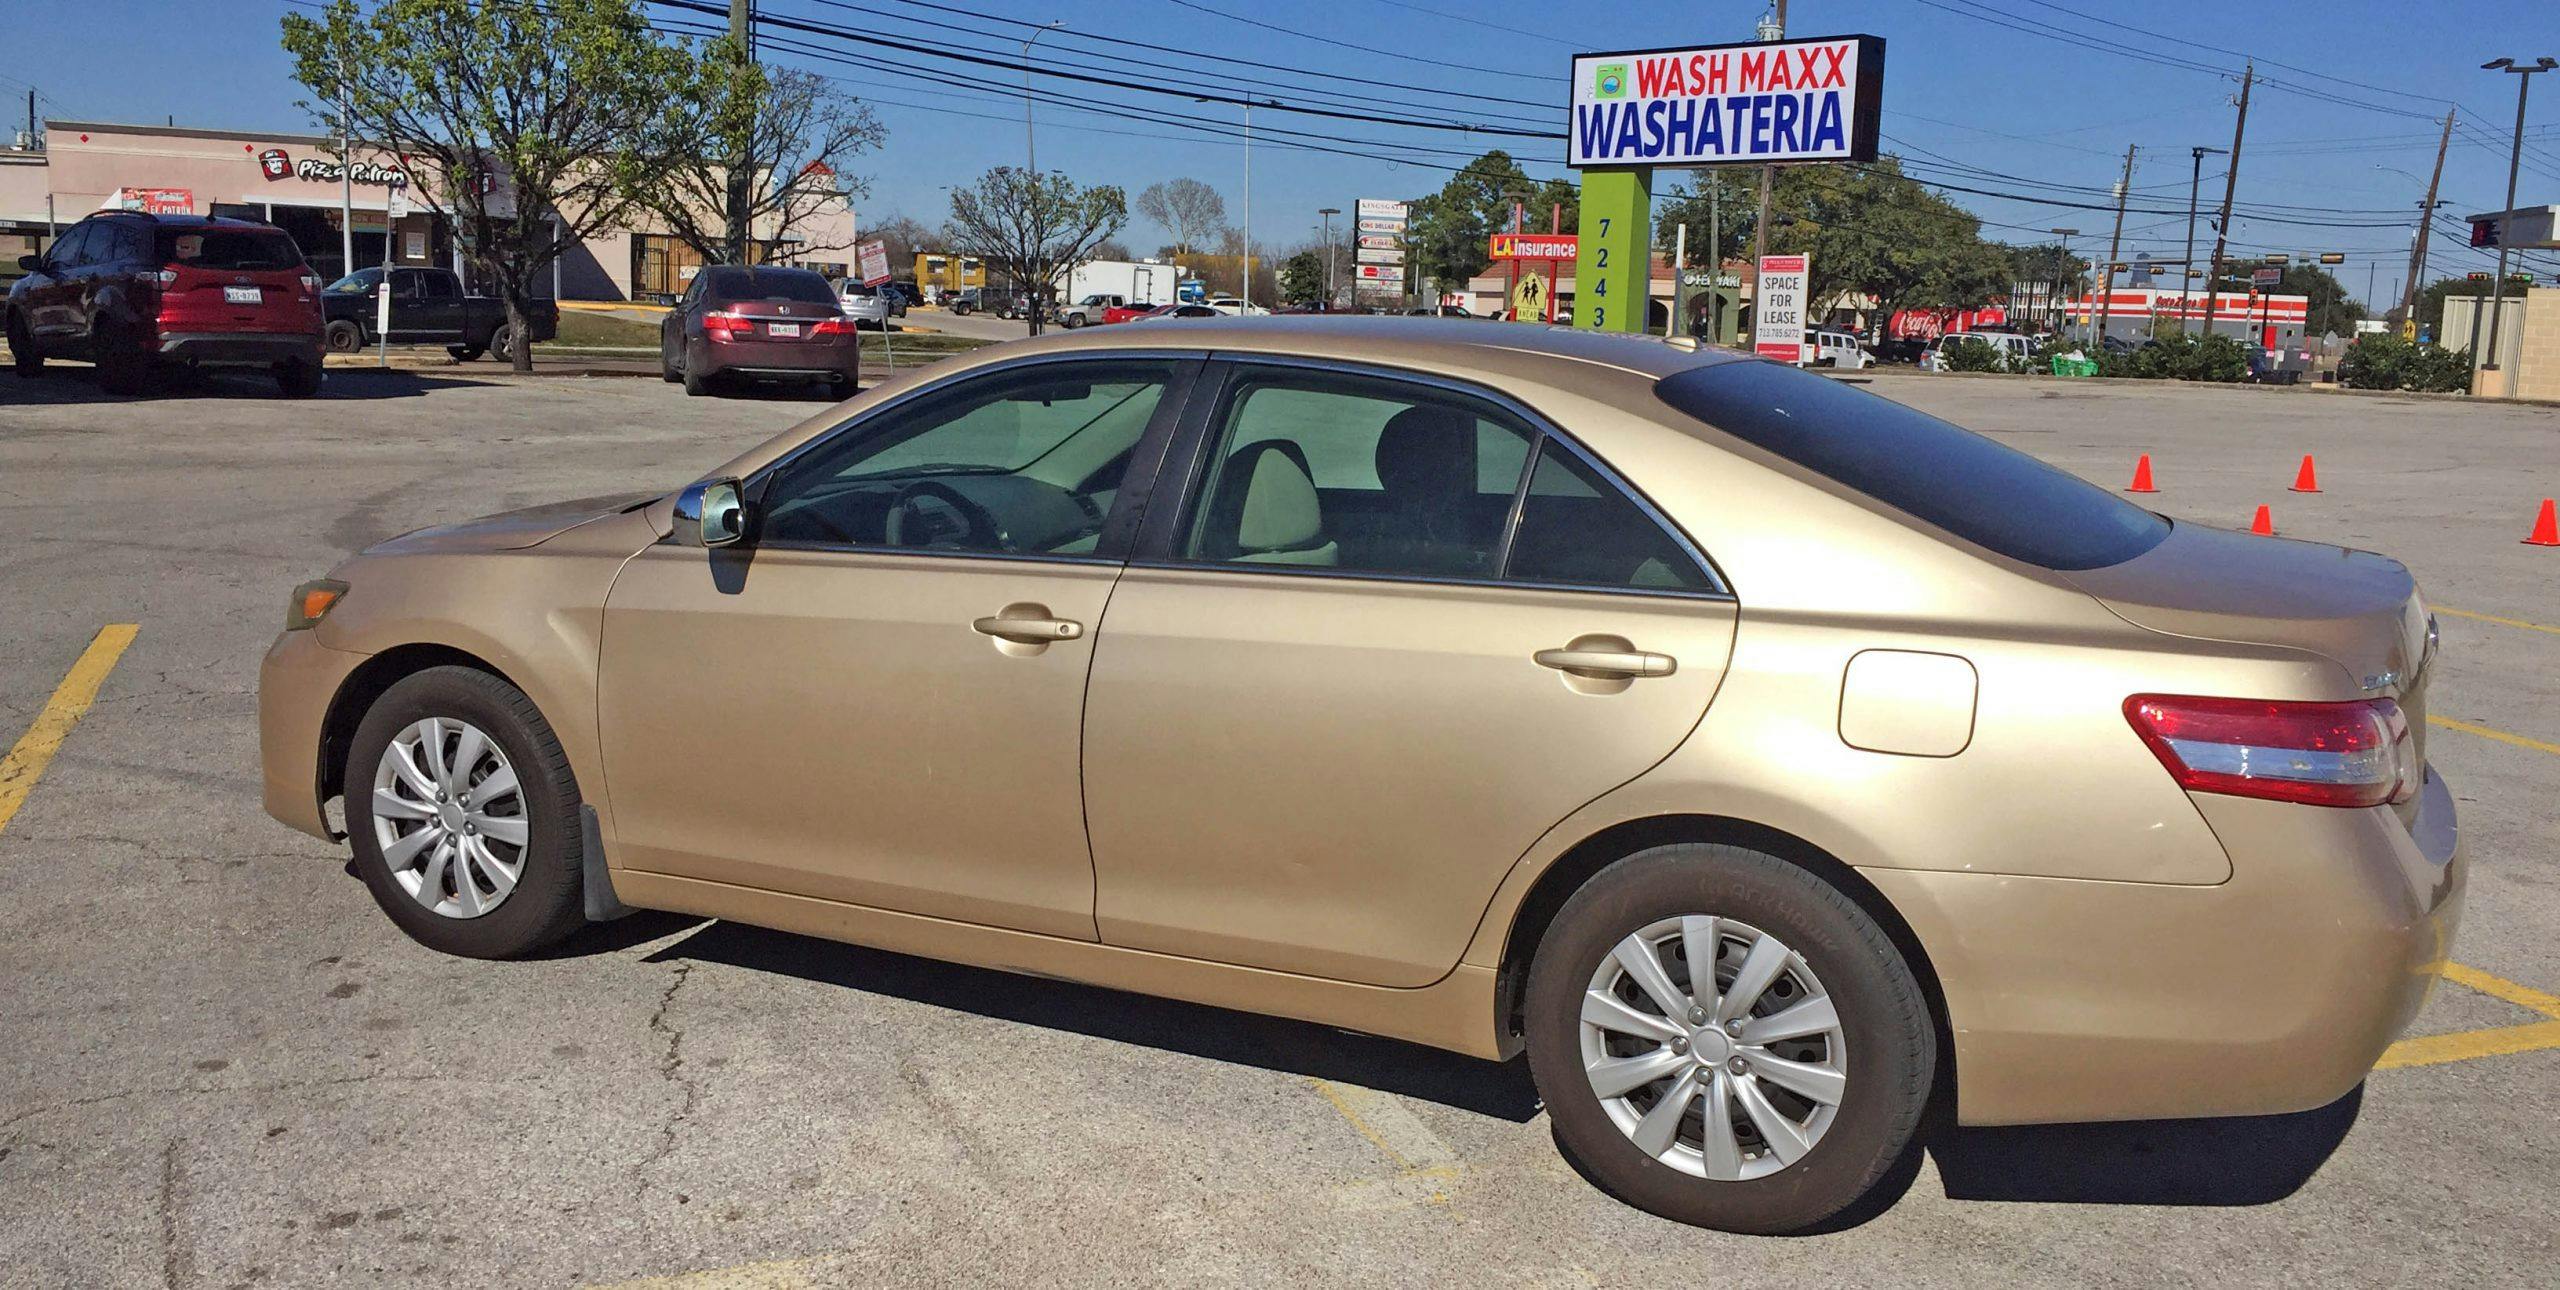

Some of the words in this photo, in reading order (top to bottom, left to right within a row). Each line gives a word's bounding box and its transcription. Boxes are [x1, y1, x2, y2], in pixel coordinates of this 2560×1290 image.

[1636, 53, 1729, 99] WASH
[1739, 44, 1850, 93] MAXX
[1578, 91, 1846, 159] WASHATERIA
[299, 160, 346, 180] Pizza
[1593, 218, 1611, 328] 7243
[1695, 274, 1740, 287] TEYAKI
[1764, 277, 1800, 290] SPACE
[1769, 294, 1792, 307] FOR
[2156, 295, 2198, 308] AutoZne
[1518, 309, 1538, 319] AHEAD
[1763, 311, 1797, 325] LEASE
